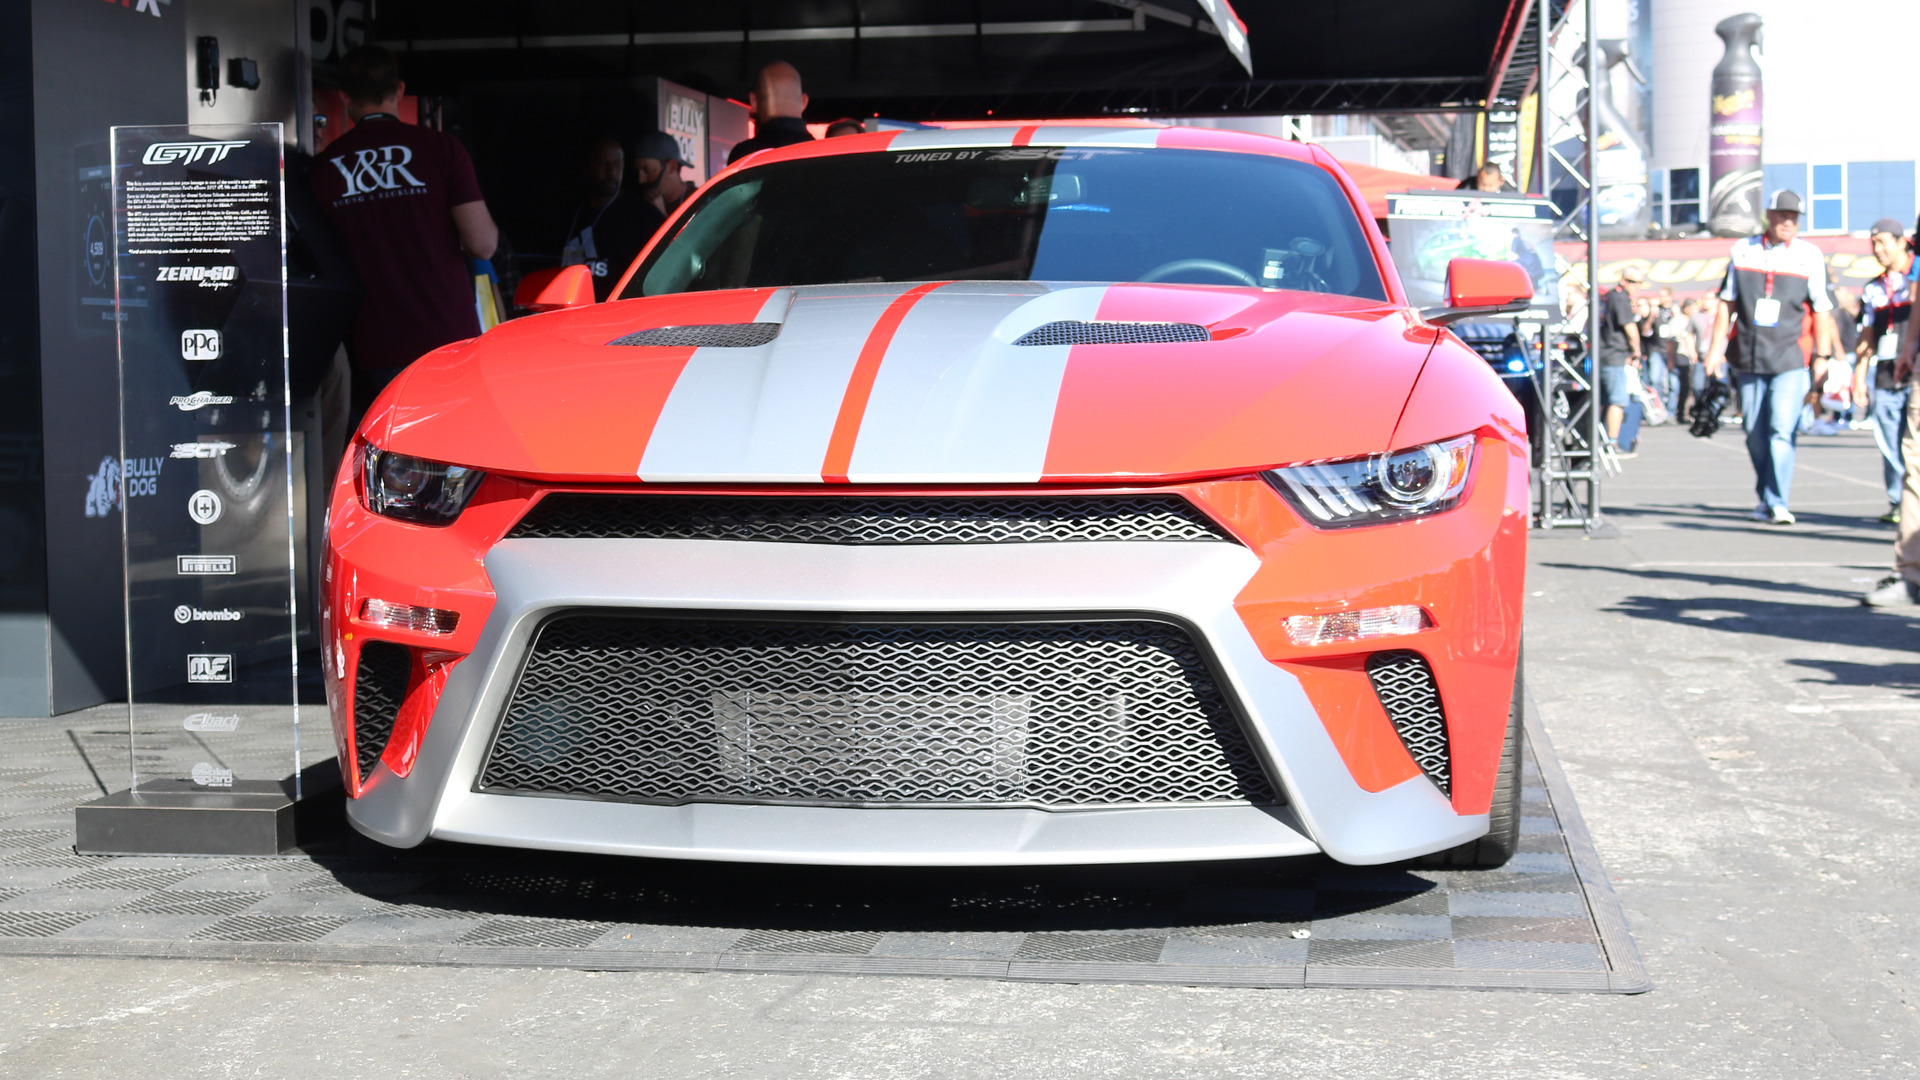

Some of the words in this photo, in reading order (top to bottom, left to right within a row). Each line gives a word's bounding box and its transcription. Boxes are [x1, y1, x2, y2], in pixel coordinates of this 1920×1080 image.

[895, 152, 952, 164] TUNED
[955, 150, 983, 161] BY
[330, 145, 426, 197] Y&R
[184, 333, 216, 356] PPG
[124, 457, 164, 478] BULLY
[129, 478, 157, 497] DOG
[182, 558, 231, 572] PIRELLI
[193, 608, 241, 621] brembo
